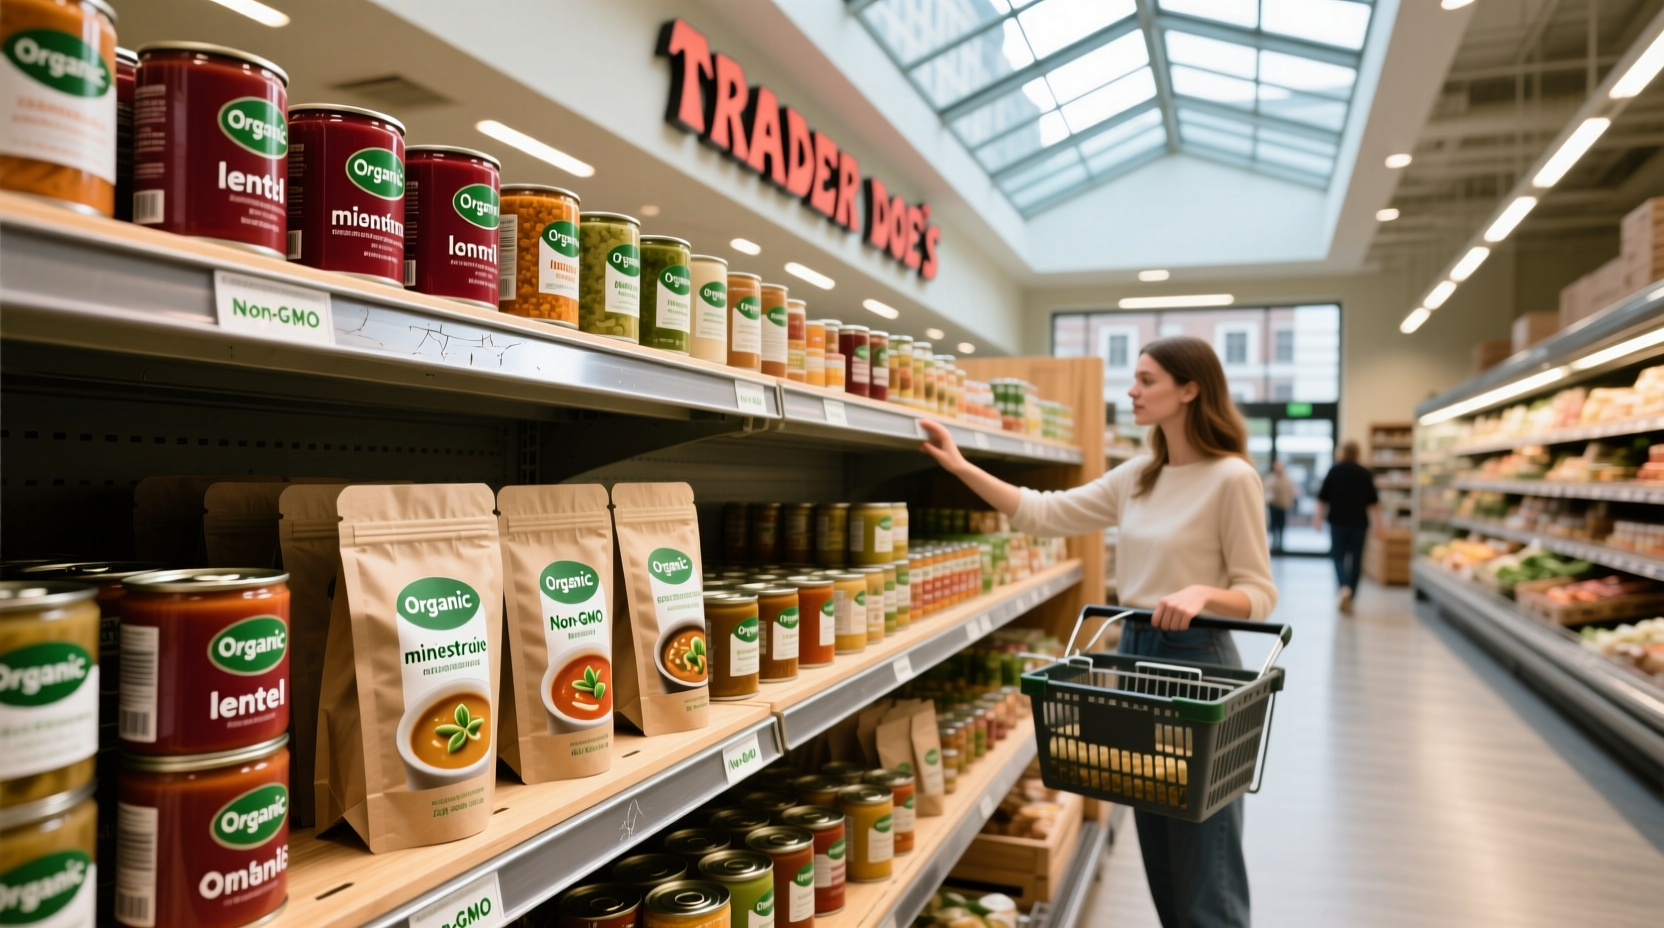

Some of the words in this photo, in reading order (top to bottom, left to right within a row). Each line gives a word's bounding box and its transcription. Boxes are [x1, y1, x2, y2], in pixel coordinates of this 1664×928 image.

[226, 109, 286, 145] Organic
[664, 18, 860, 233] TRADER
[869, 177, 941, 281] DOE'S
[232, 297, 320, 329] Non-GMO
[546, 571, 594, 593] Organic
[404, 590, 473, 617] Organic
[218, 629, 285, 661] Organic
[210, 678, 285, 720] lentel
[220, 795, 286, 834] Organic
